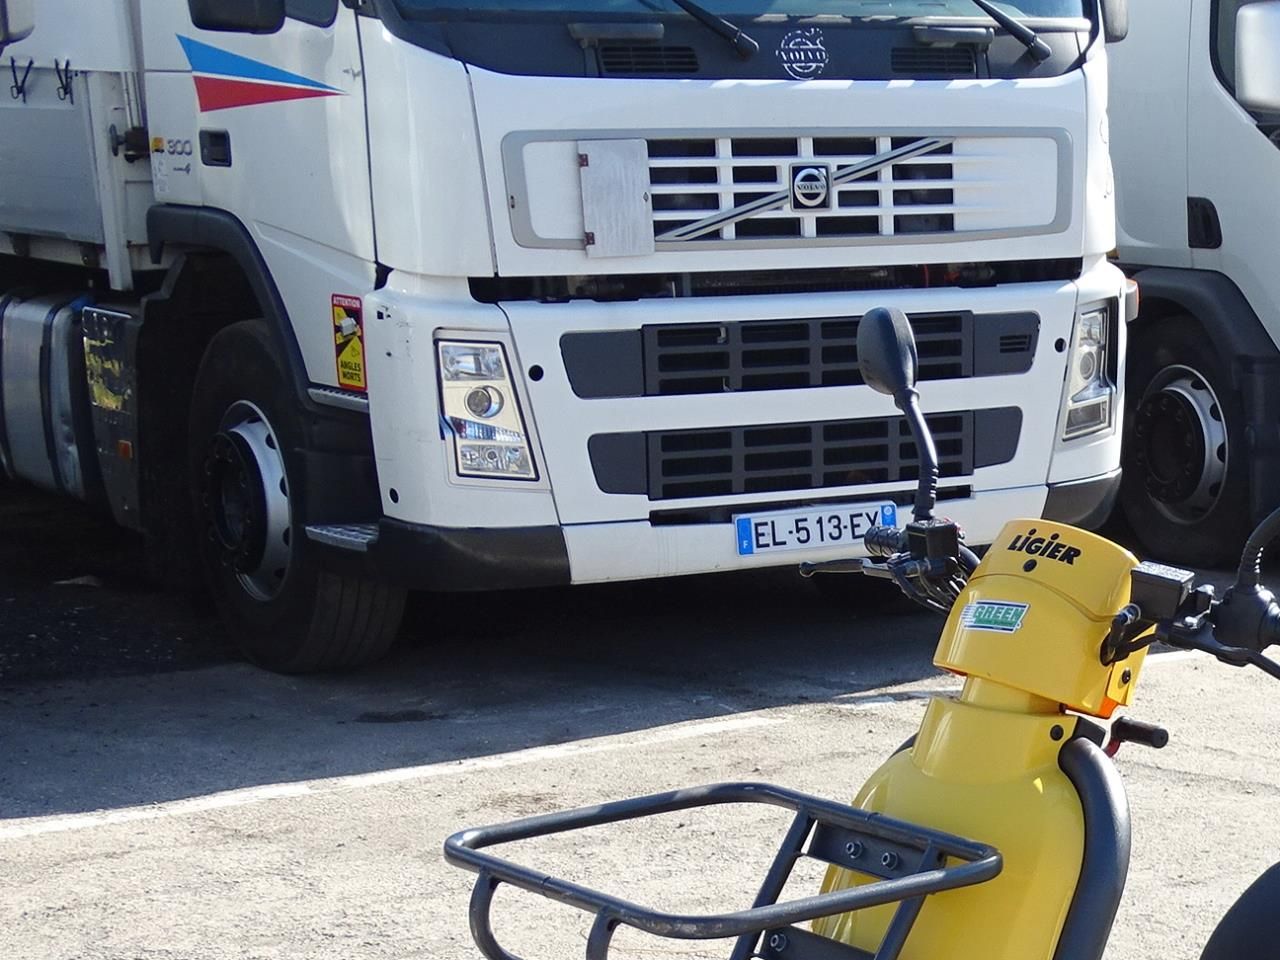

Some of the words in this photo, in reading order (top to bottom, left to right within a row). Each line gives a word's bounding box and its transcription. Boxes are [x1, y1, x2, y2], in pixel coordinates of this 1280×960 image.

[167, 139, 193, 155] 300
[796, 183, 826, 191] VOLVO
[340, 359, 362, 372] ANGLES
[342, 369, 362, 382] MORTS
[973, 605, 1025, 622] GREEN
